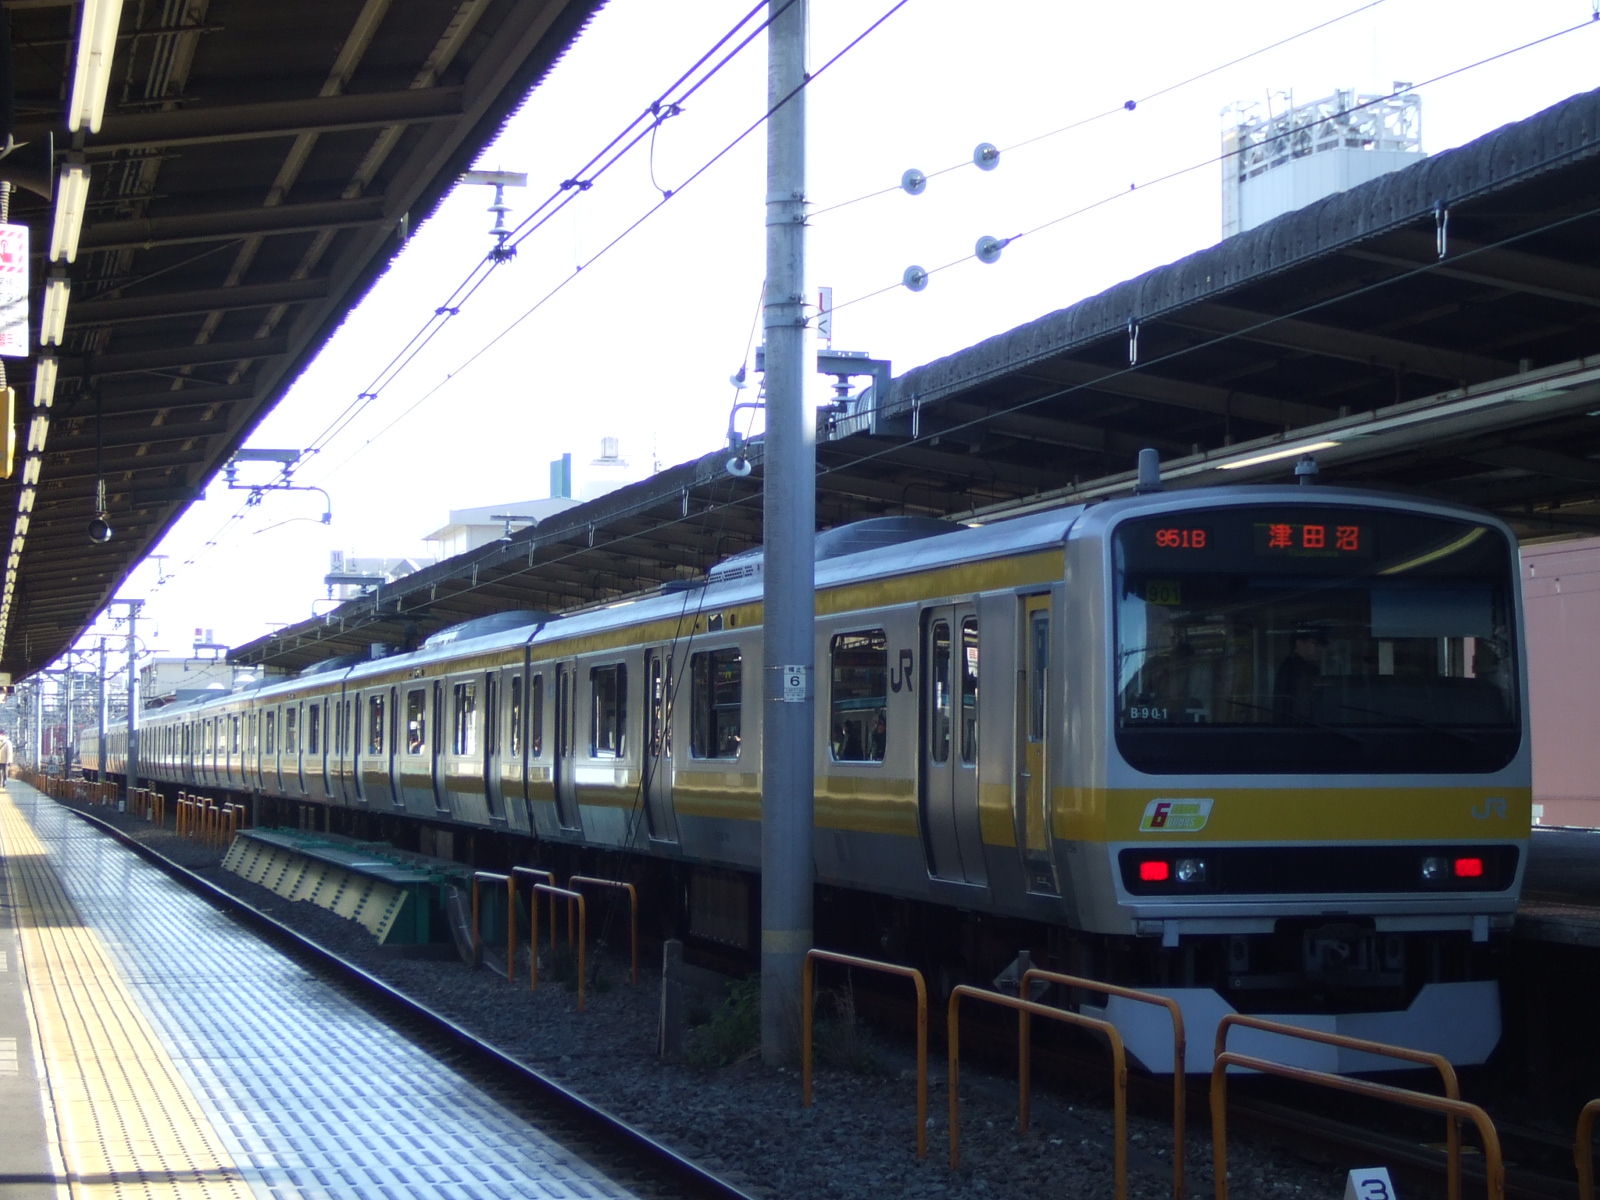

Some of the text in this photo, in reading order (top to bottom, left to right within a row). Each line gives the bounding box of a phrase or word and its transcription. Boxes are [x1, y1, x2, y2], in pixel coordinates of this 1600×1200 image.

[1268, 523, 1360, 551] 津田沼
[790, 675, 800, 687] 6
[890, 649, 913, 693] JR
[1150, 802, 1172, 828] 6
[1472, 797, 1508, 819] JR
[1361, 1178, 1389, 1200] 3
